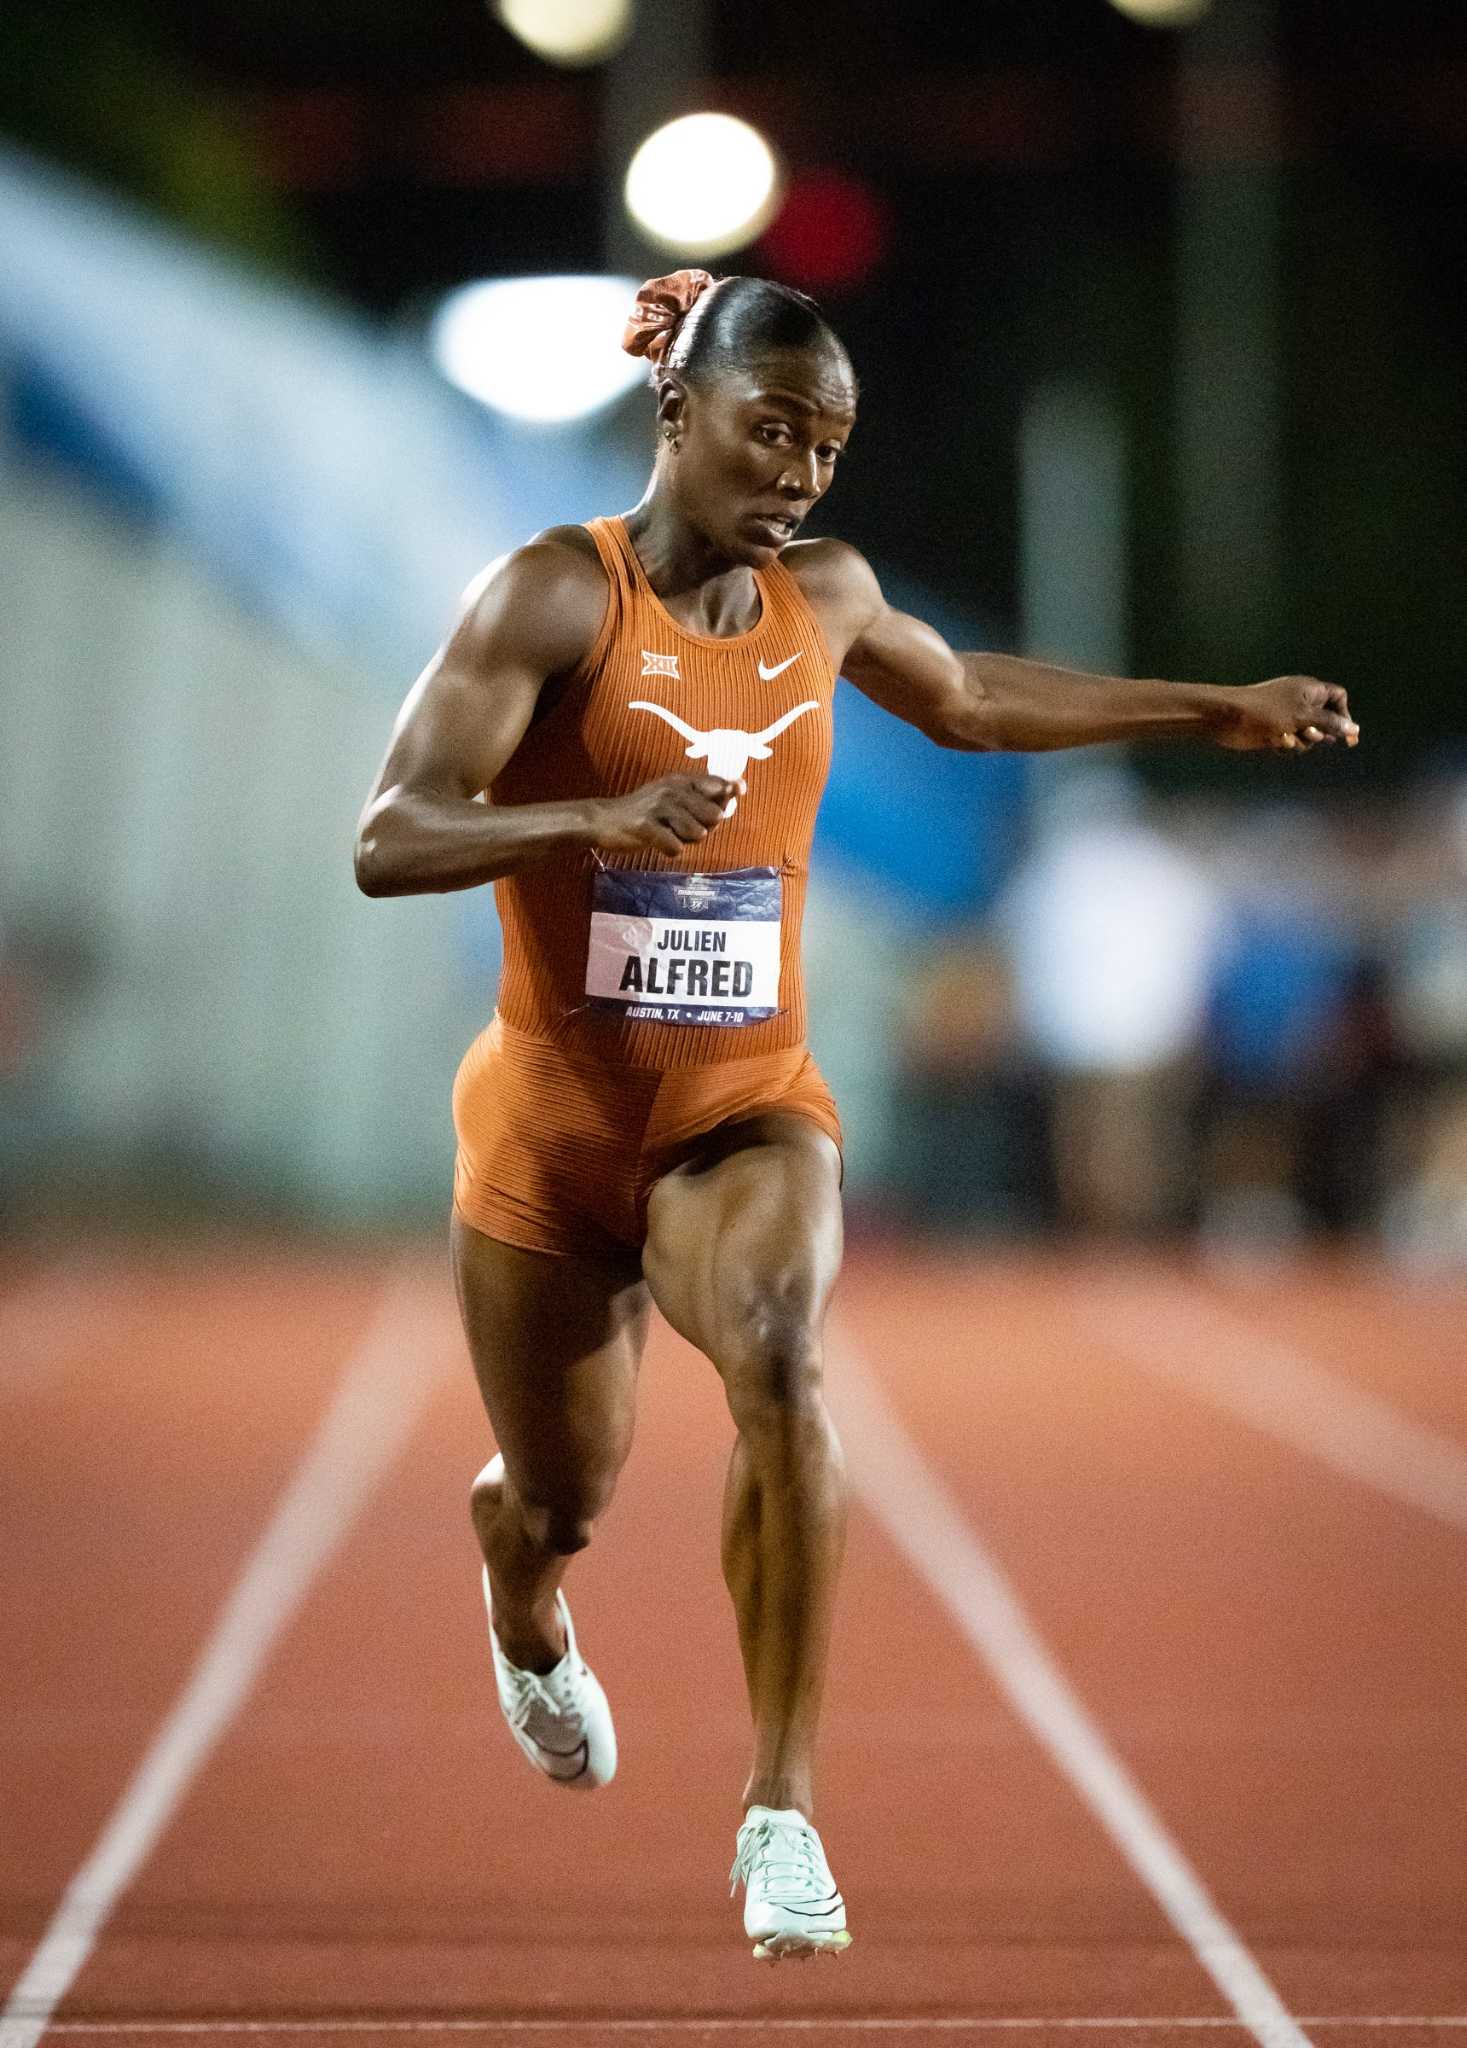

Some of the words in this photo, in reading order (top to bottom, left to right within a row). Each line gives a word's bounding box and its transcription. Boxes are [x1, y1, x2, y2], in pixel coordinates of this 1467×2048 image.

[657, 930, 727, 952] JULIEN
[619, 955, 753, 997] ALFRED
[625, 1006, 663, 1020] AUSTIN,
[666, 1008, 680, 1020] TX
[697, 1010, 723, 1022] JUNE
[725, 1011, 744, 1022] 7-10
